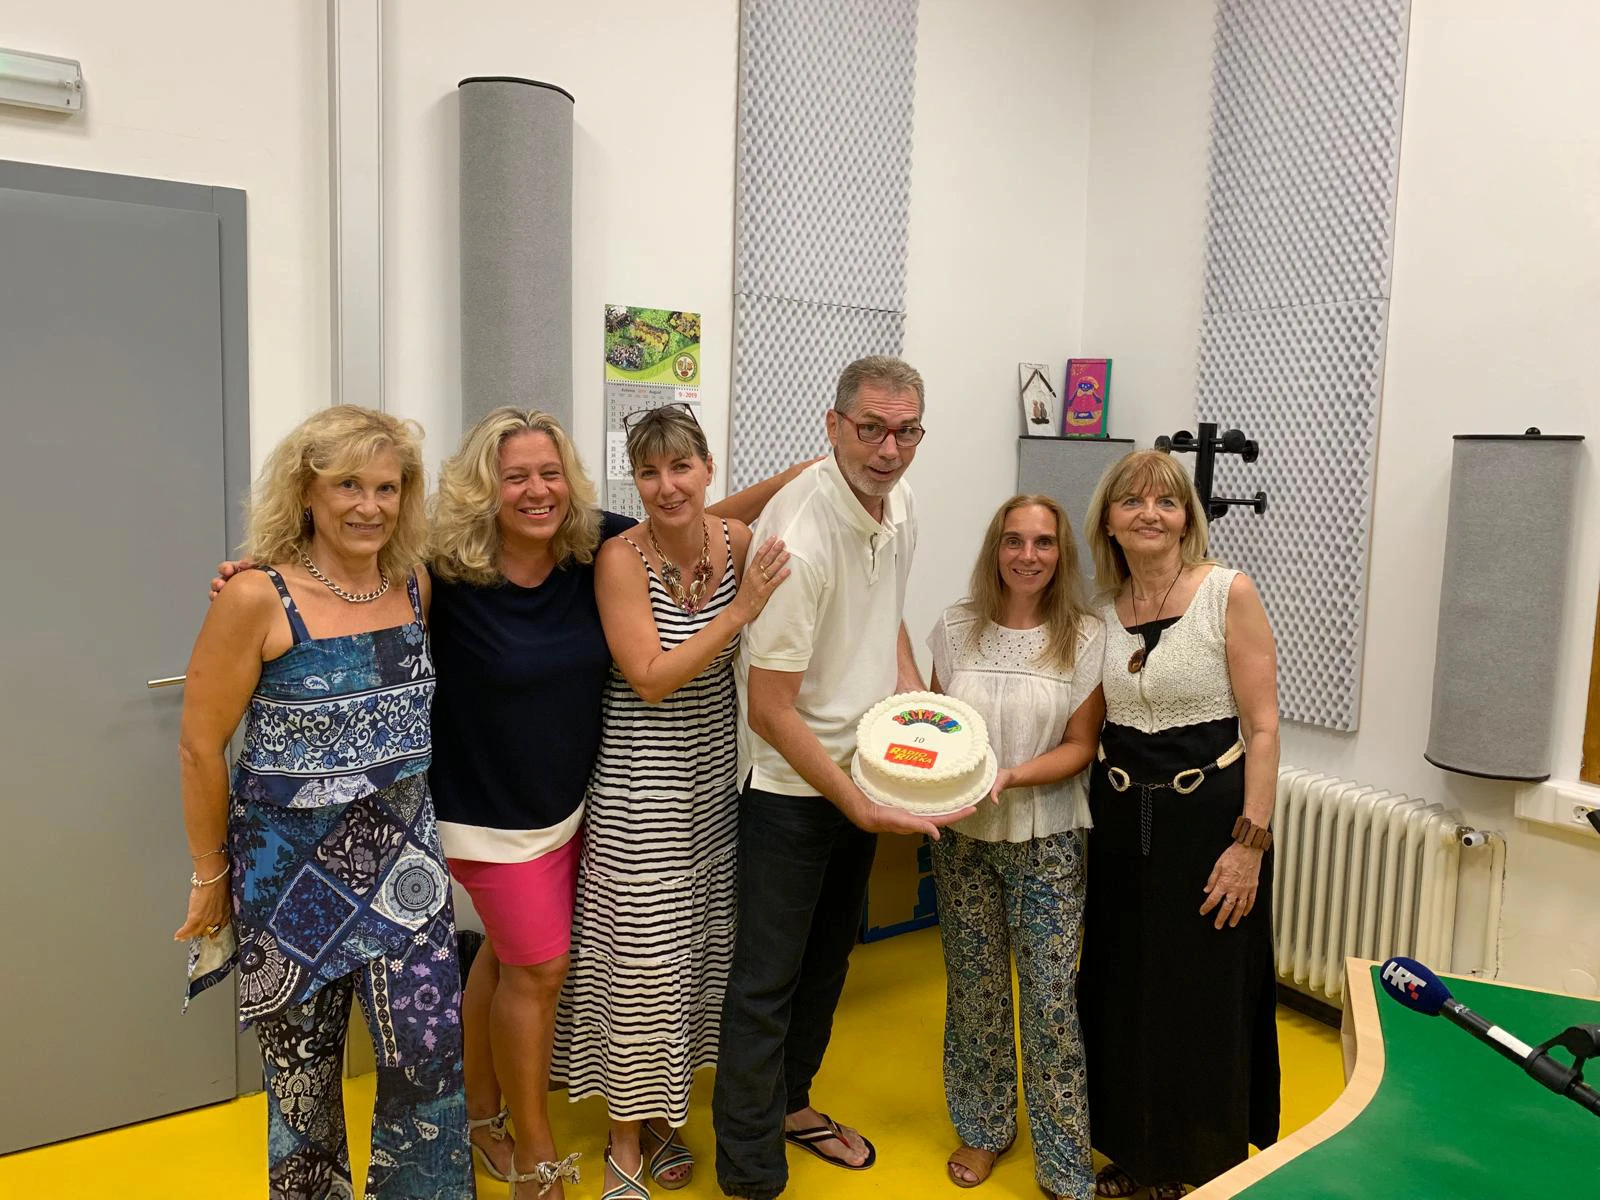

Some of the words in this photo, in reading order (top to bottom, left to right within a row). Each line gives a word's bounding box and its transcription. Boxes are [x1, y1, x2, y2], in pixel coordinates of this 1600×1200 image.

[913, 736, 925, 744] 10
[889, 747, 927, 758] RADIO
[1382, 961, 1427, 1000] HRT
